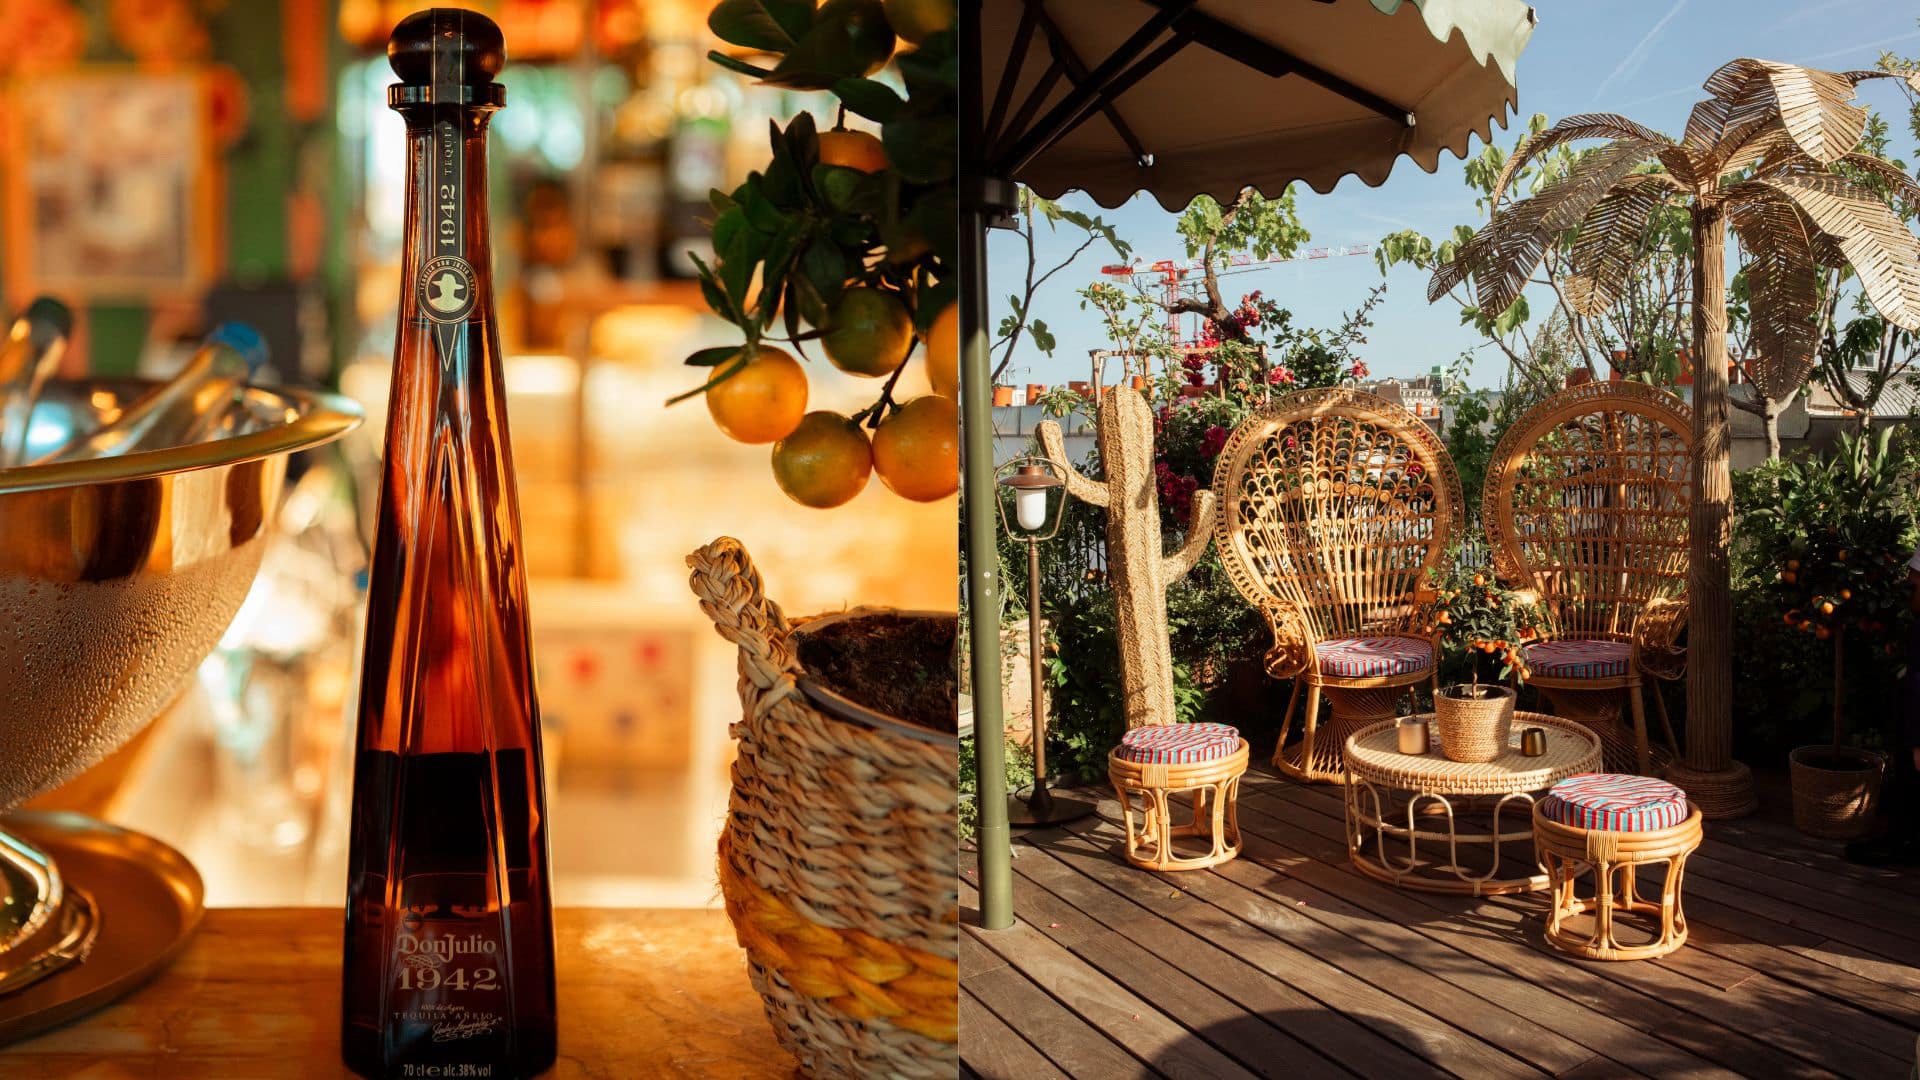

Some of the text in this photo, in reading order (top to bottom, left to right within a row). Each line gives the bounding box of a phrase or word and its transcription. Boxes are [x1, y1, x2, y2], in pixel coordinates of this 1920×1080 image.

[440, 126, 456, 248] 1942 TEQUIL
[393, 1012, 447, 1020] TEQUILA
[403, 1063, 415, 1077] 70
[416, 1063, 425, 1077] cl
[478, 1063, 492, 1077] vol
